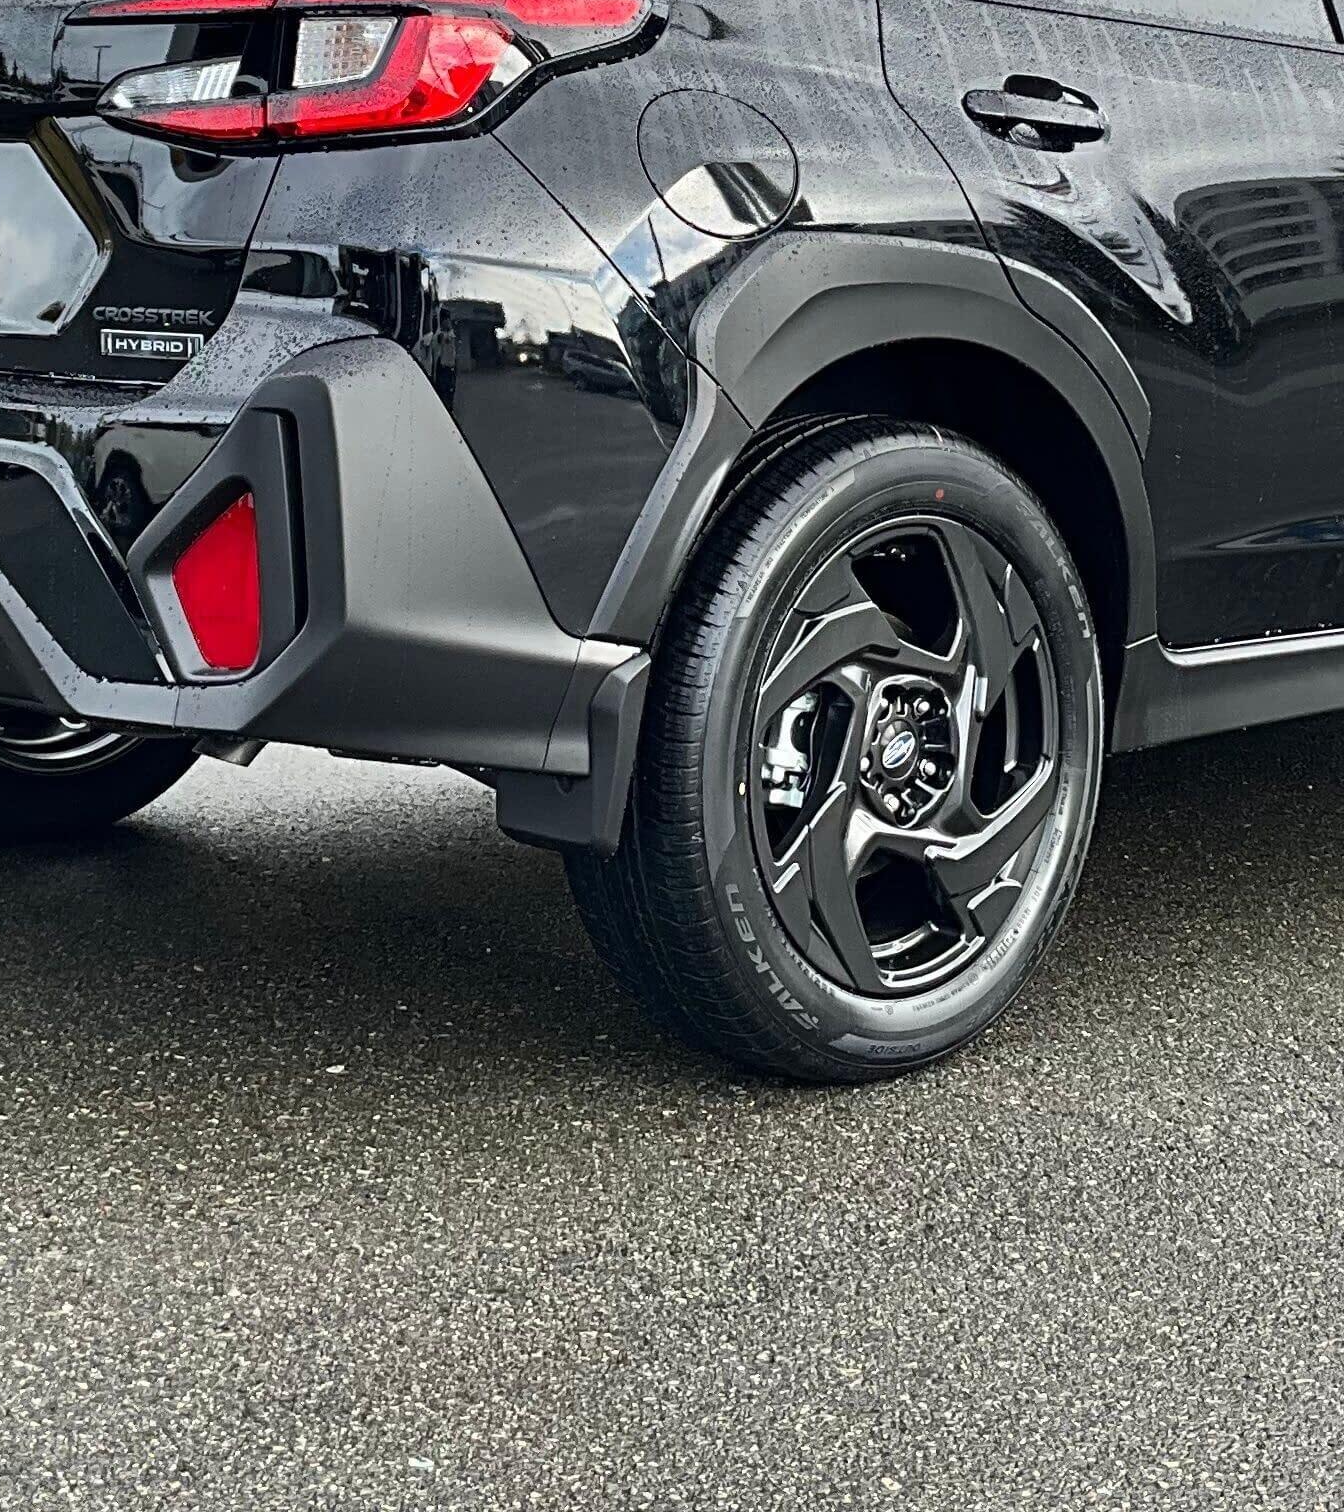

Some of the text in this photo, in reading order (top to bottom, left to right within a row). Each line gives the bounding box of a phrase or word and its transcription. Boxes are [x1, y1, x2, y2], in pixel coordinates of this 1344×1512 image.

[92, 306, 216, 326] CROSSTREK
[115, 338, 184, 353] HYBRID
[725, 883, 820, 1030] FALKEN
